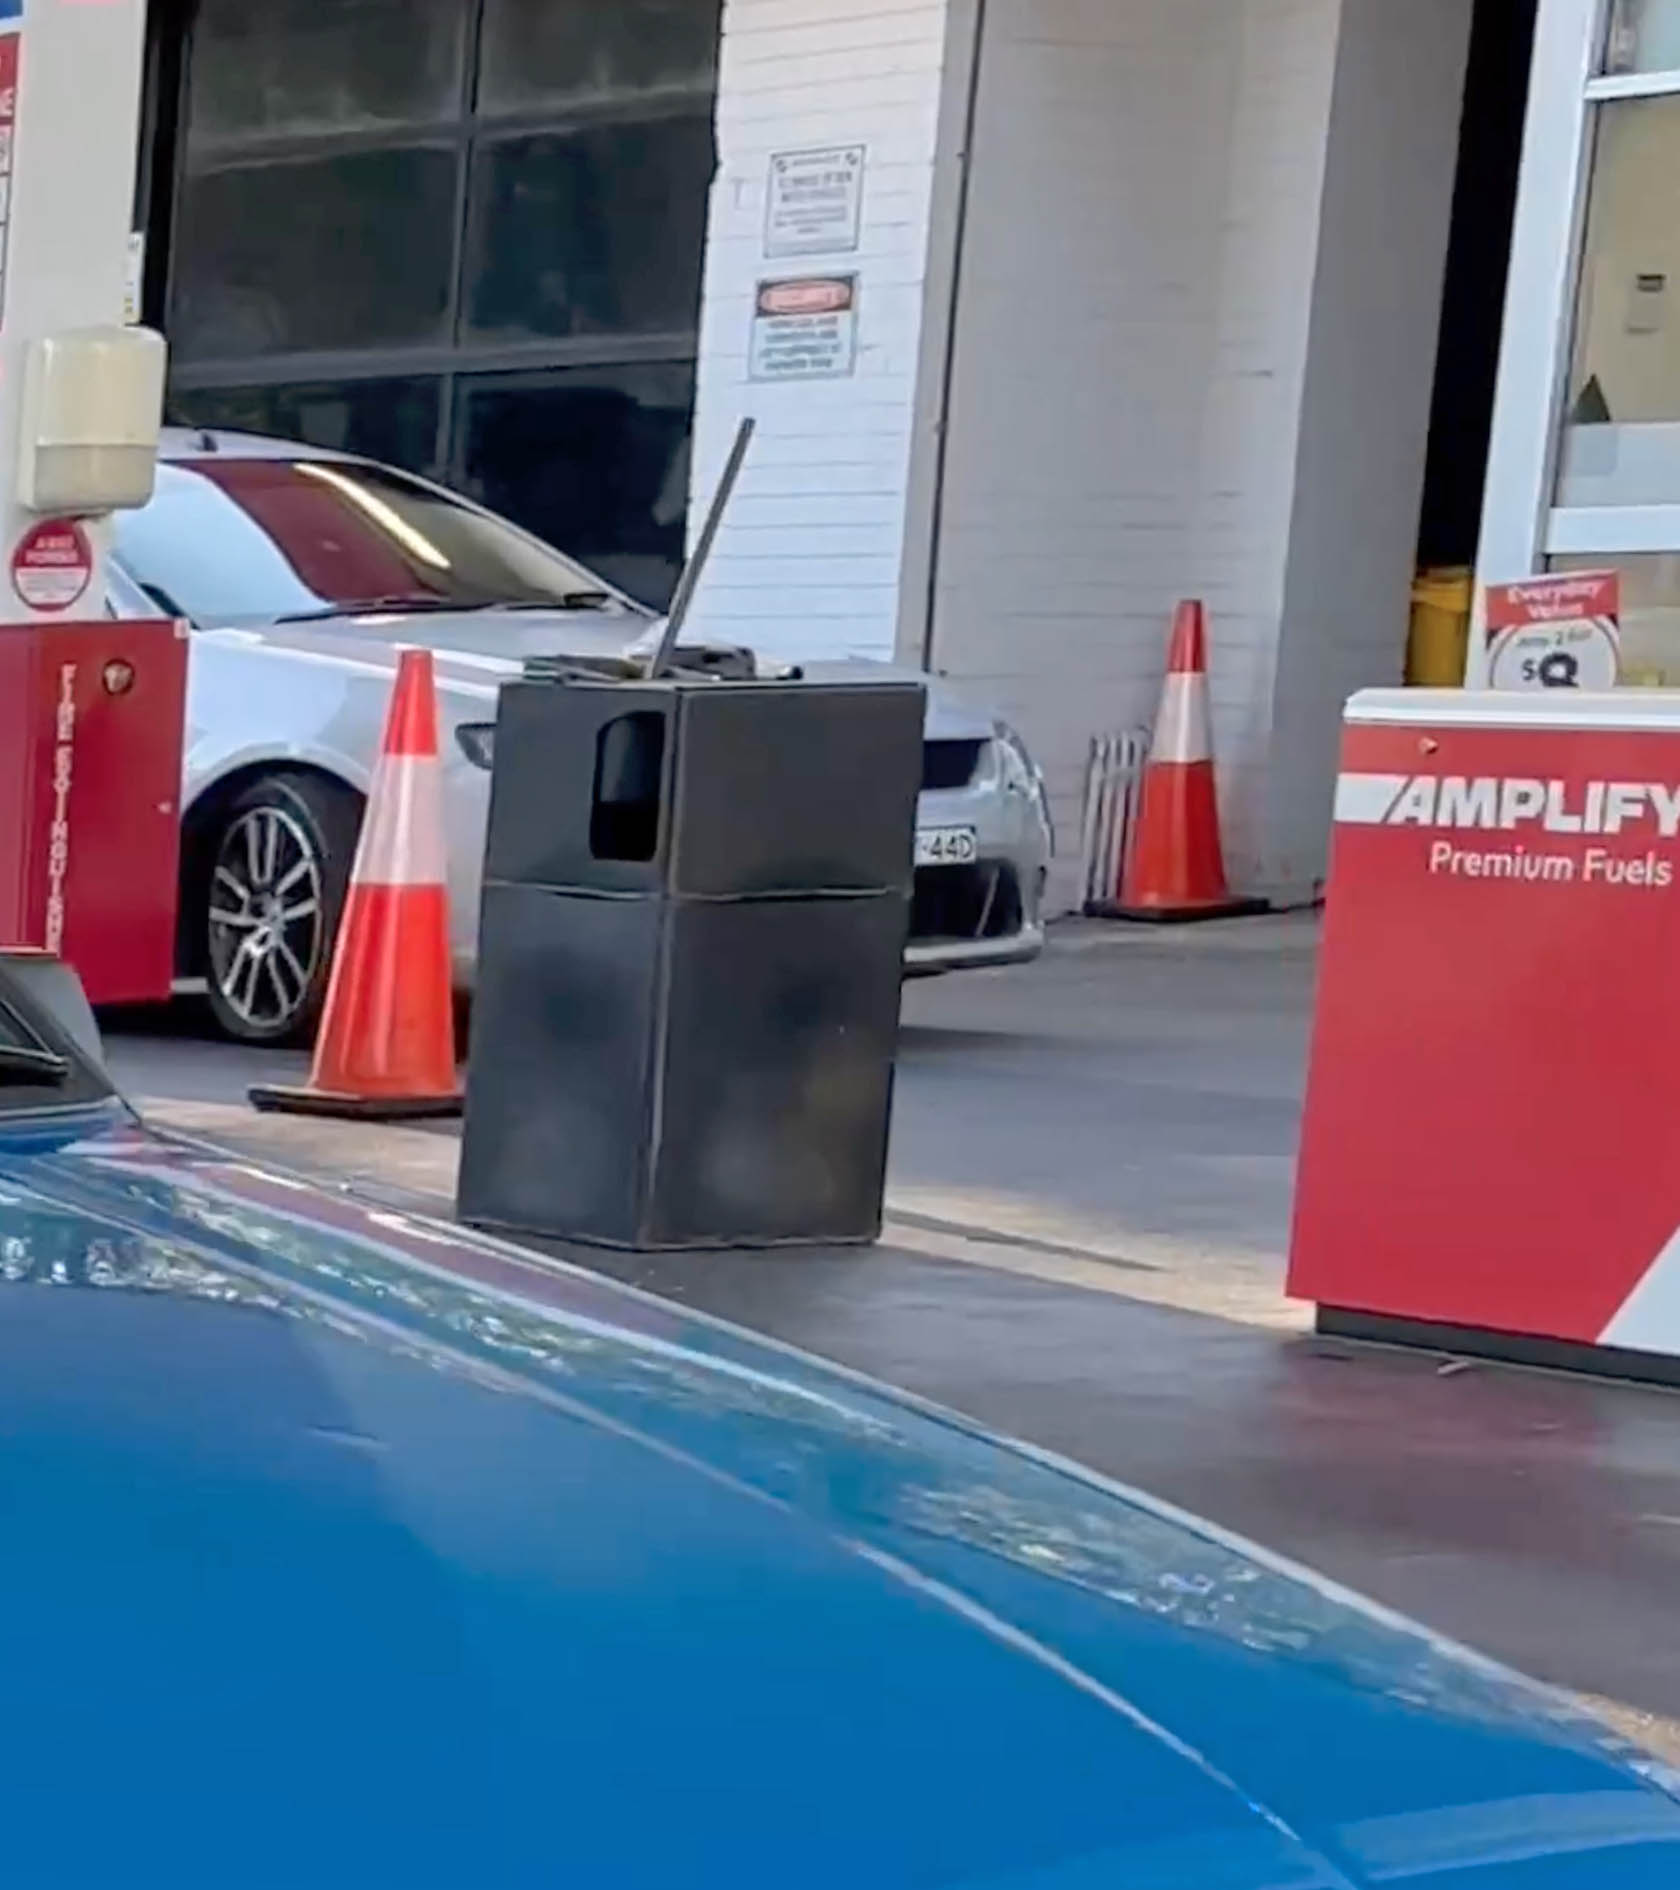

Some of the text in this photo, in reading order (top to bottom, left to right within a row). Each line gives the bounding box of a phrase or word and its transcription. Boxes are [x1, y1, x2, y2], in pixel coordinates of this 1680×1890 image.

[1384, 774, 1680, 838] AMPLIFY
[1428, 841, 1673, 887] Premium Fuels
